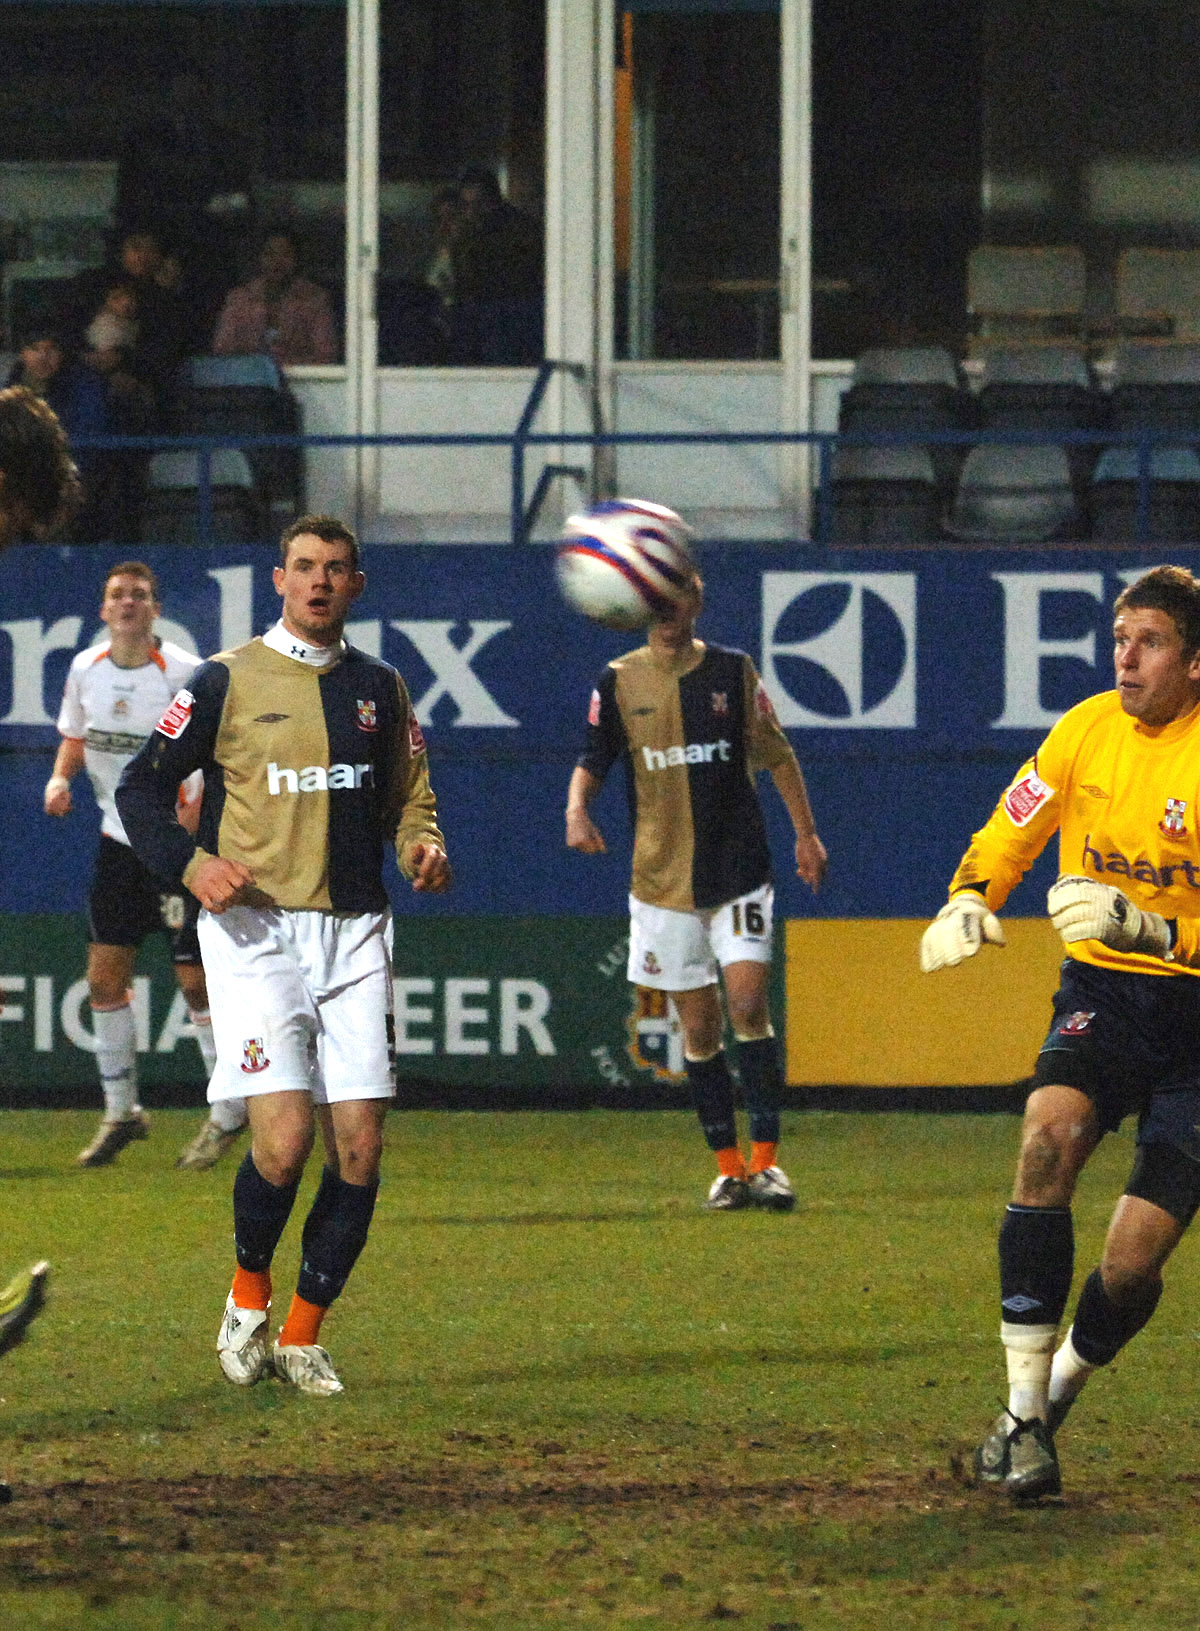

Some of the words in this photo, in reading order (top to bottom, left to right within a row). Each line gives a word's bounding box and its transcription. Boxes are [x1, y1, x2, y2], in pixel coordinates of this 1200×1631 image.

[642, 739, 732, 772] haart
[266, 761, 376, 796] haar
[1081, 834, 1200, 889] haart
[732, 901, 766, 936] 16
[392, 977, 557, 1056] EER
